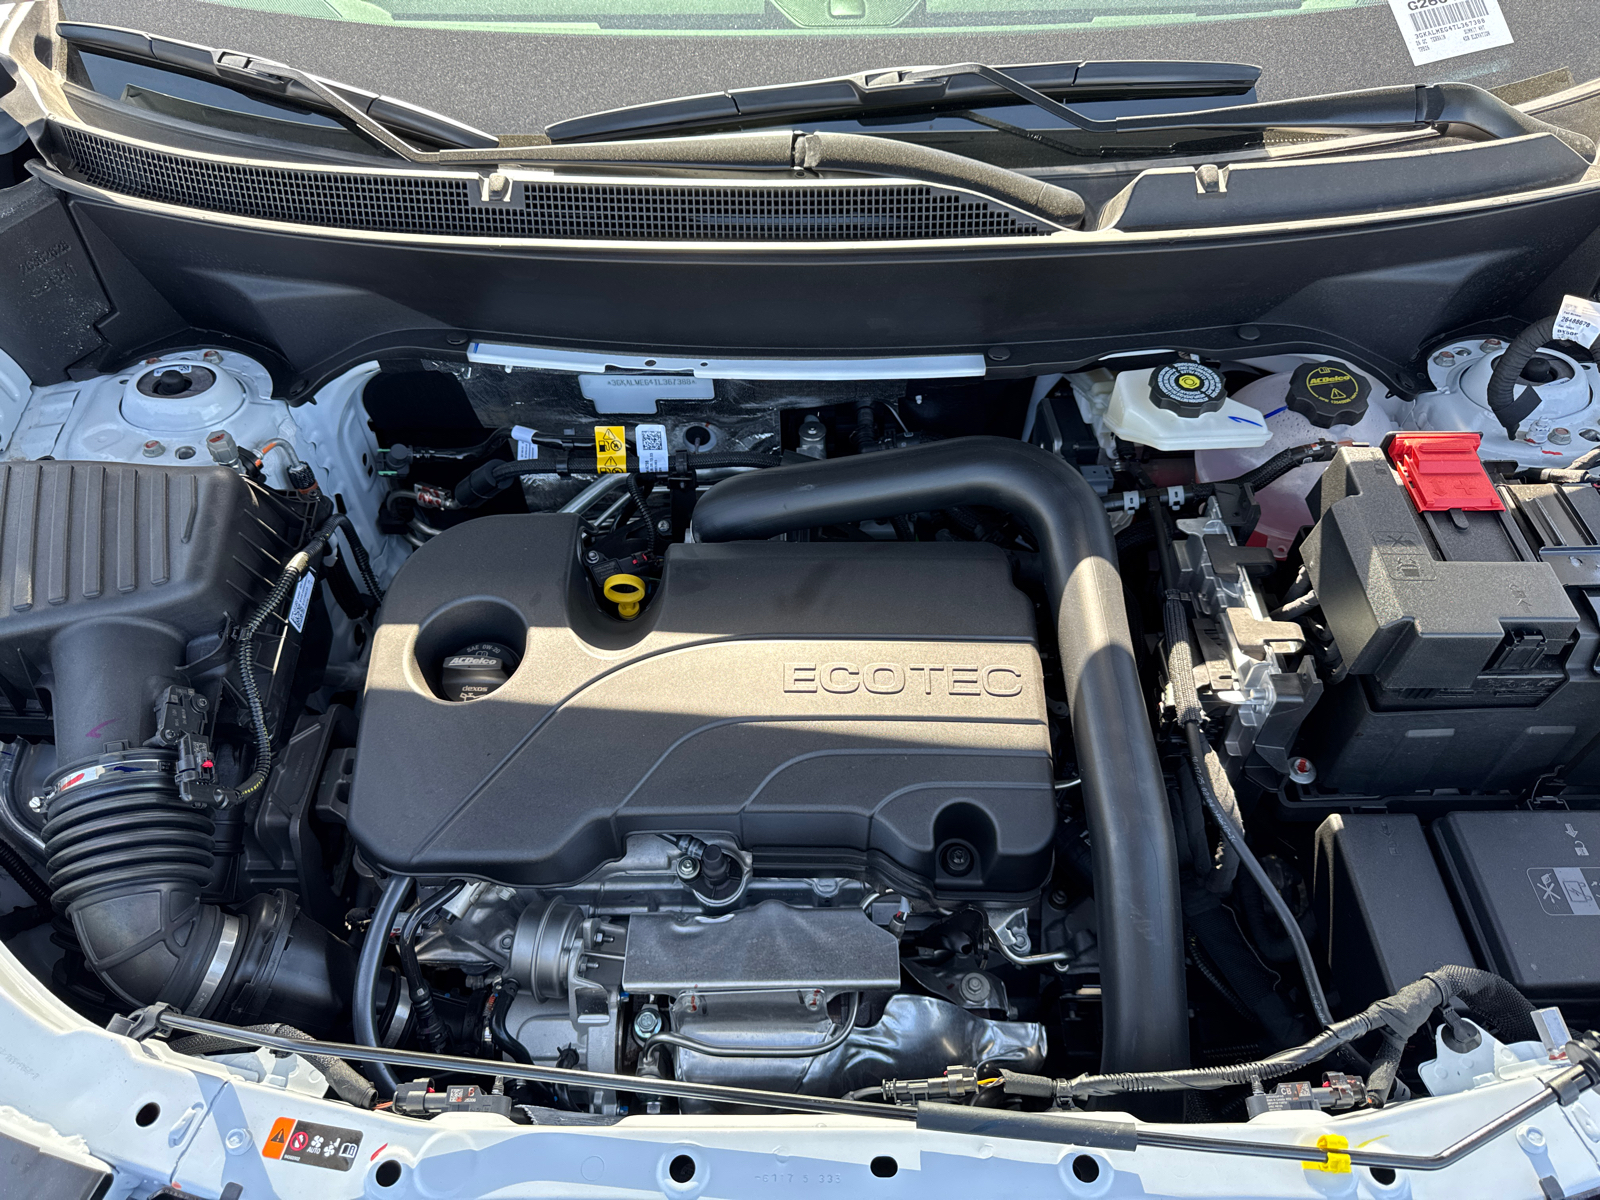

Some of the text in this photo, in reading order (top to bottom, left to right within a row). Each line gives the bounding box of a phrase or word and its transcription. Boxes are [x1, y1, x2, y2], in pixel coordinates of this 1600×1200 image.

[1309, 375, 1351, 386] ACDelco
[466, 644, 501, 654] SAE 0W-20
[448, 657, 497, 666] ACDelco
[783, 661, 1023, 698] ECOTEC
[306, 1146, 321, 1155] AUTO
